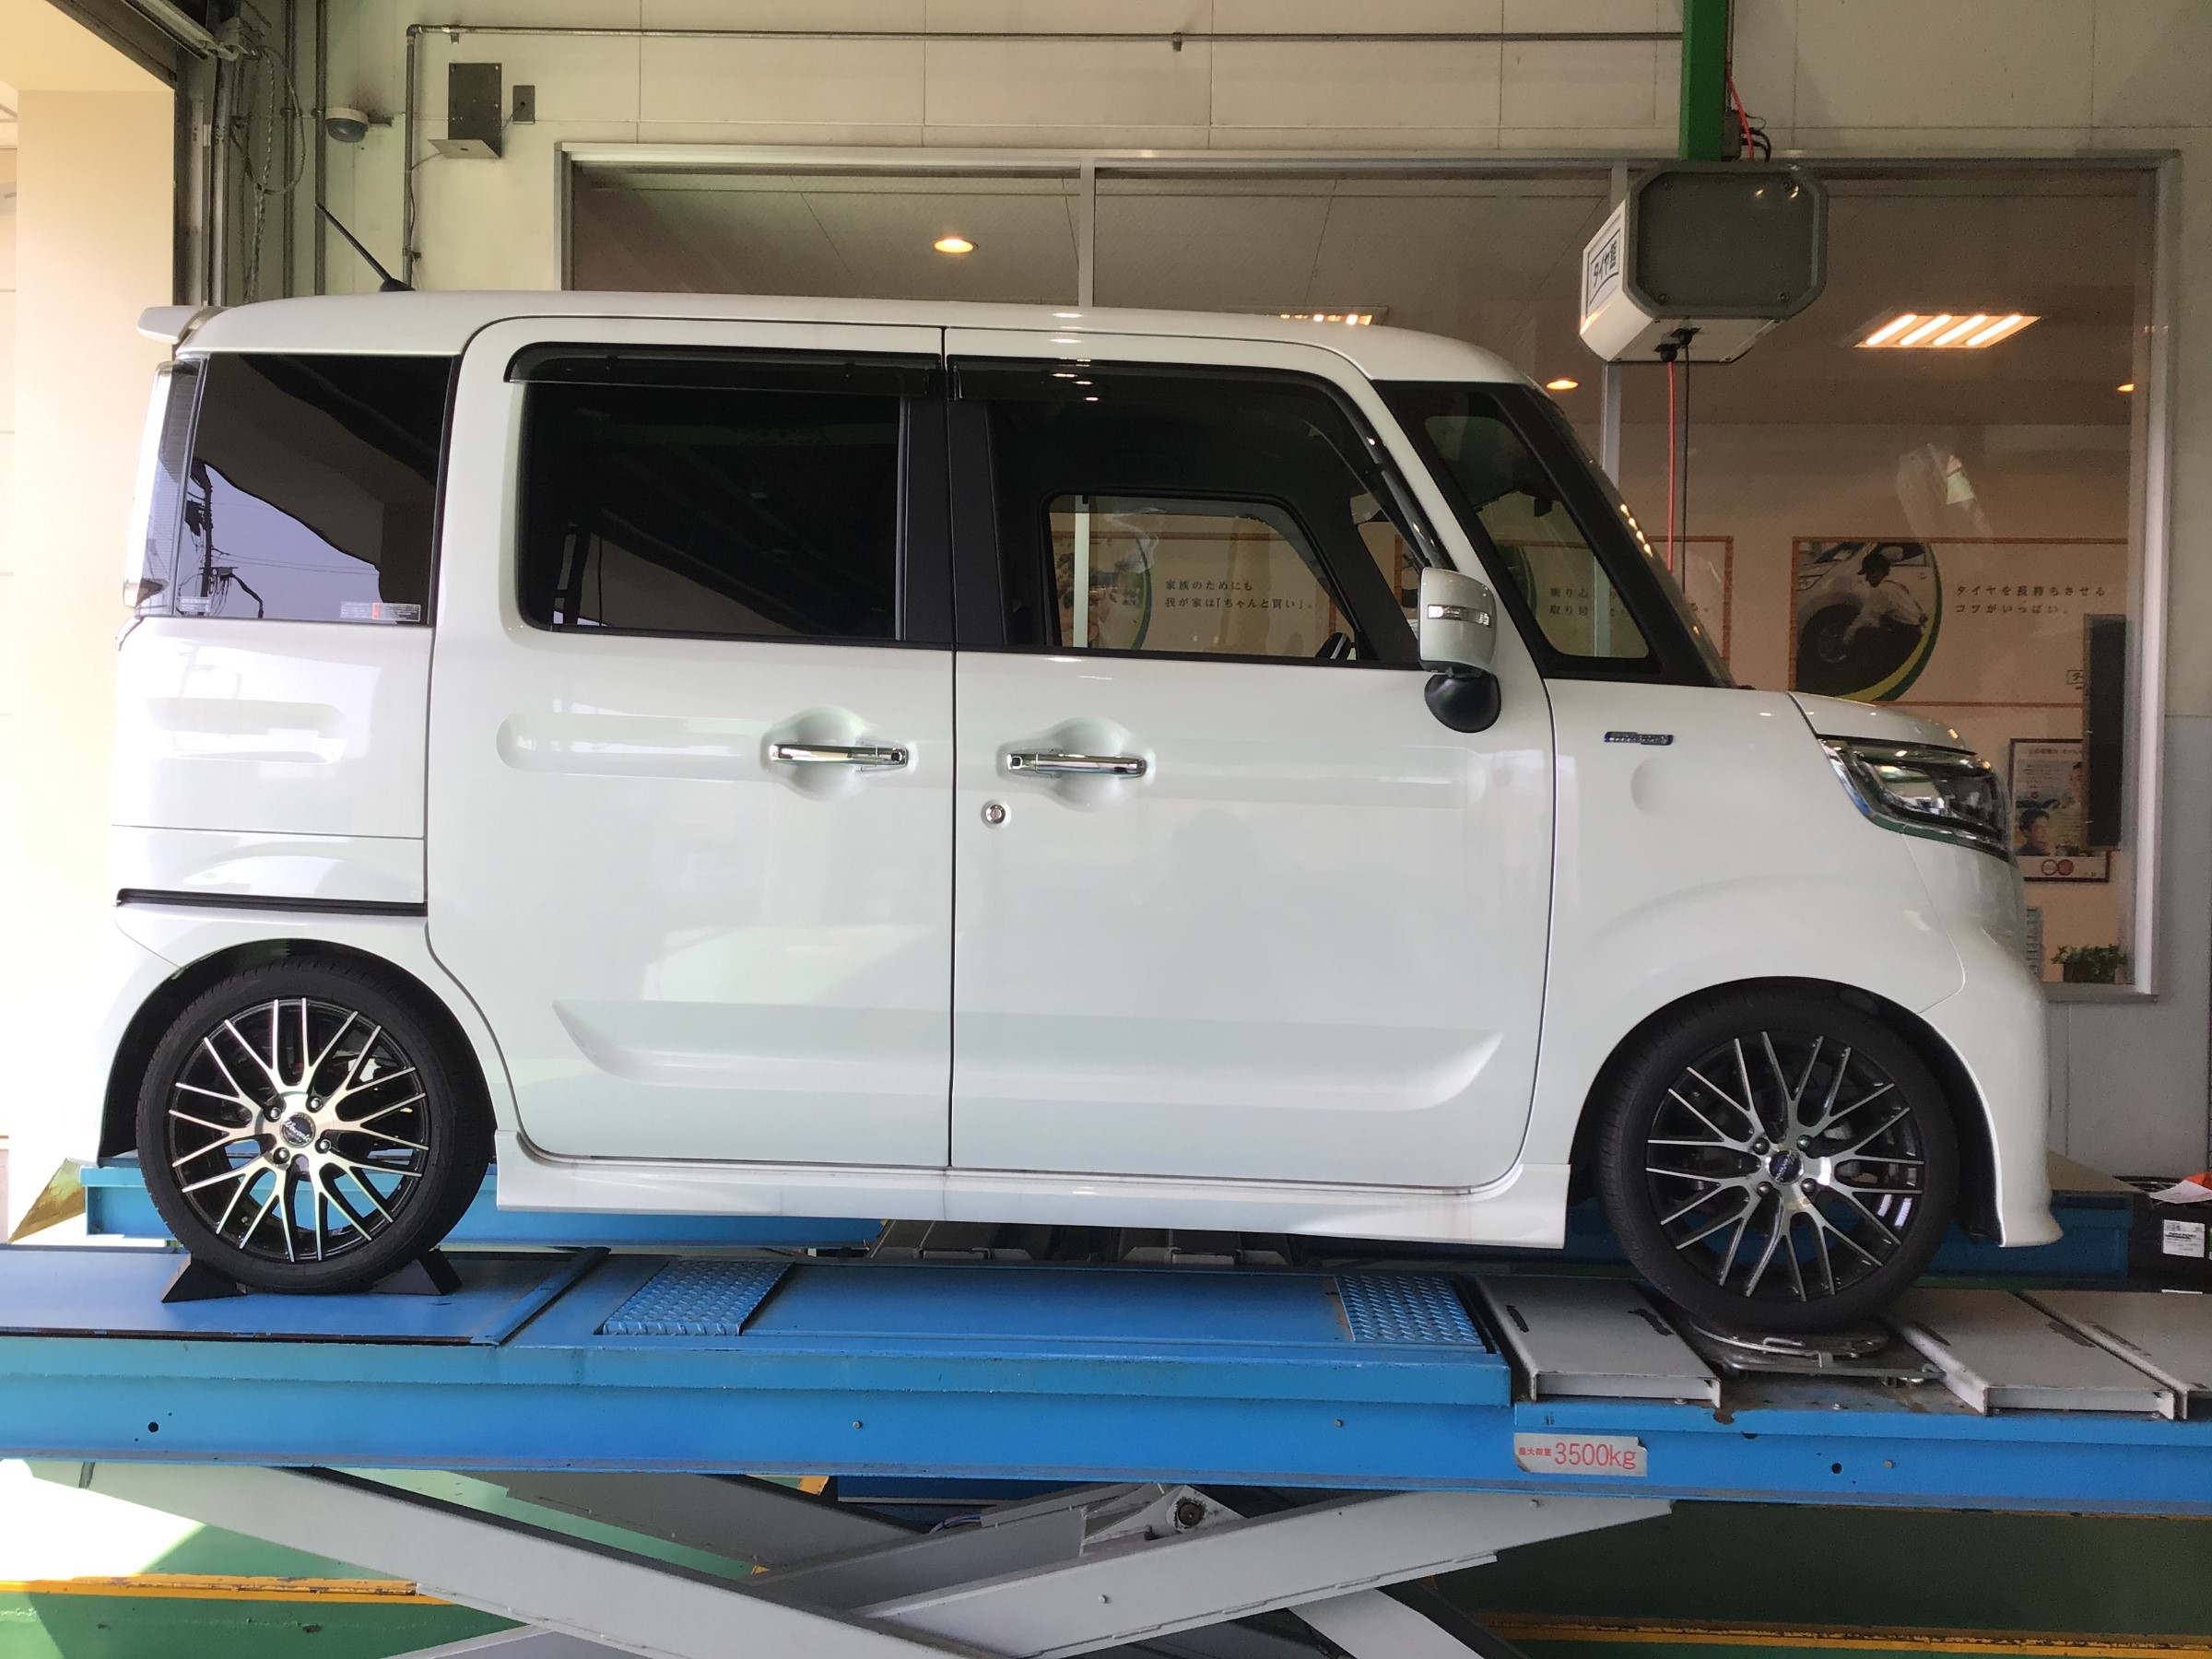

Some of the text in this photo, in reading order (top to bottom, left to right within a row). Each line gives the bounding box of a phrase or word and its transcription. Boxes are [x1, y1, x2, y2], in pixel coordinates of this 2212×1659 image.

[1165, 580, 1253, 591] 家族のためにも
[1957, 585, 2106, 596] タイヤを長持ちさせる
[1165, 597, 1312, 609] 我が家は「ちゃんと買い」。
[1956, 605, 2068, 615] コツがいっぱい。
[1518, 1441, 1637, 1470] 最大荷重 3500kg
